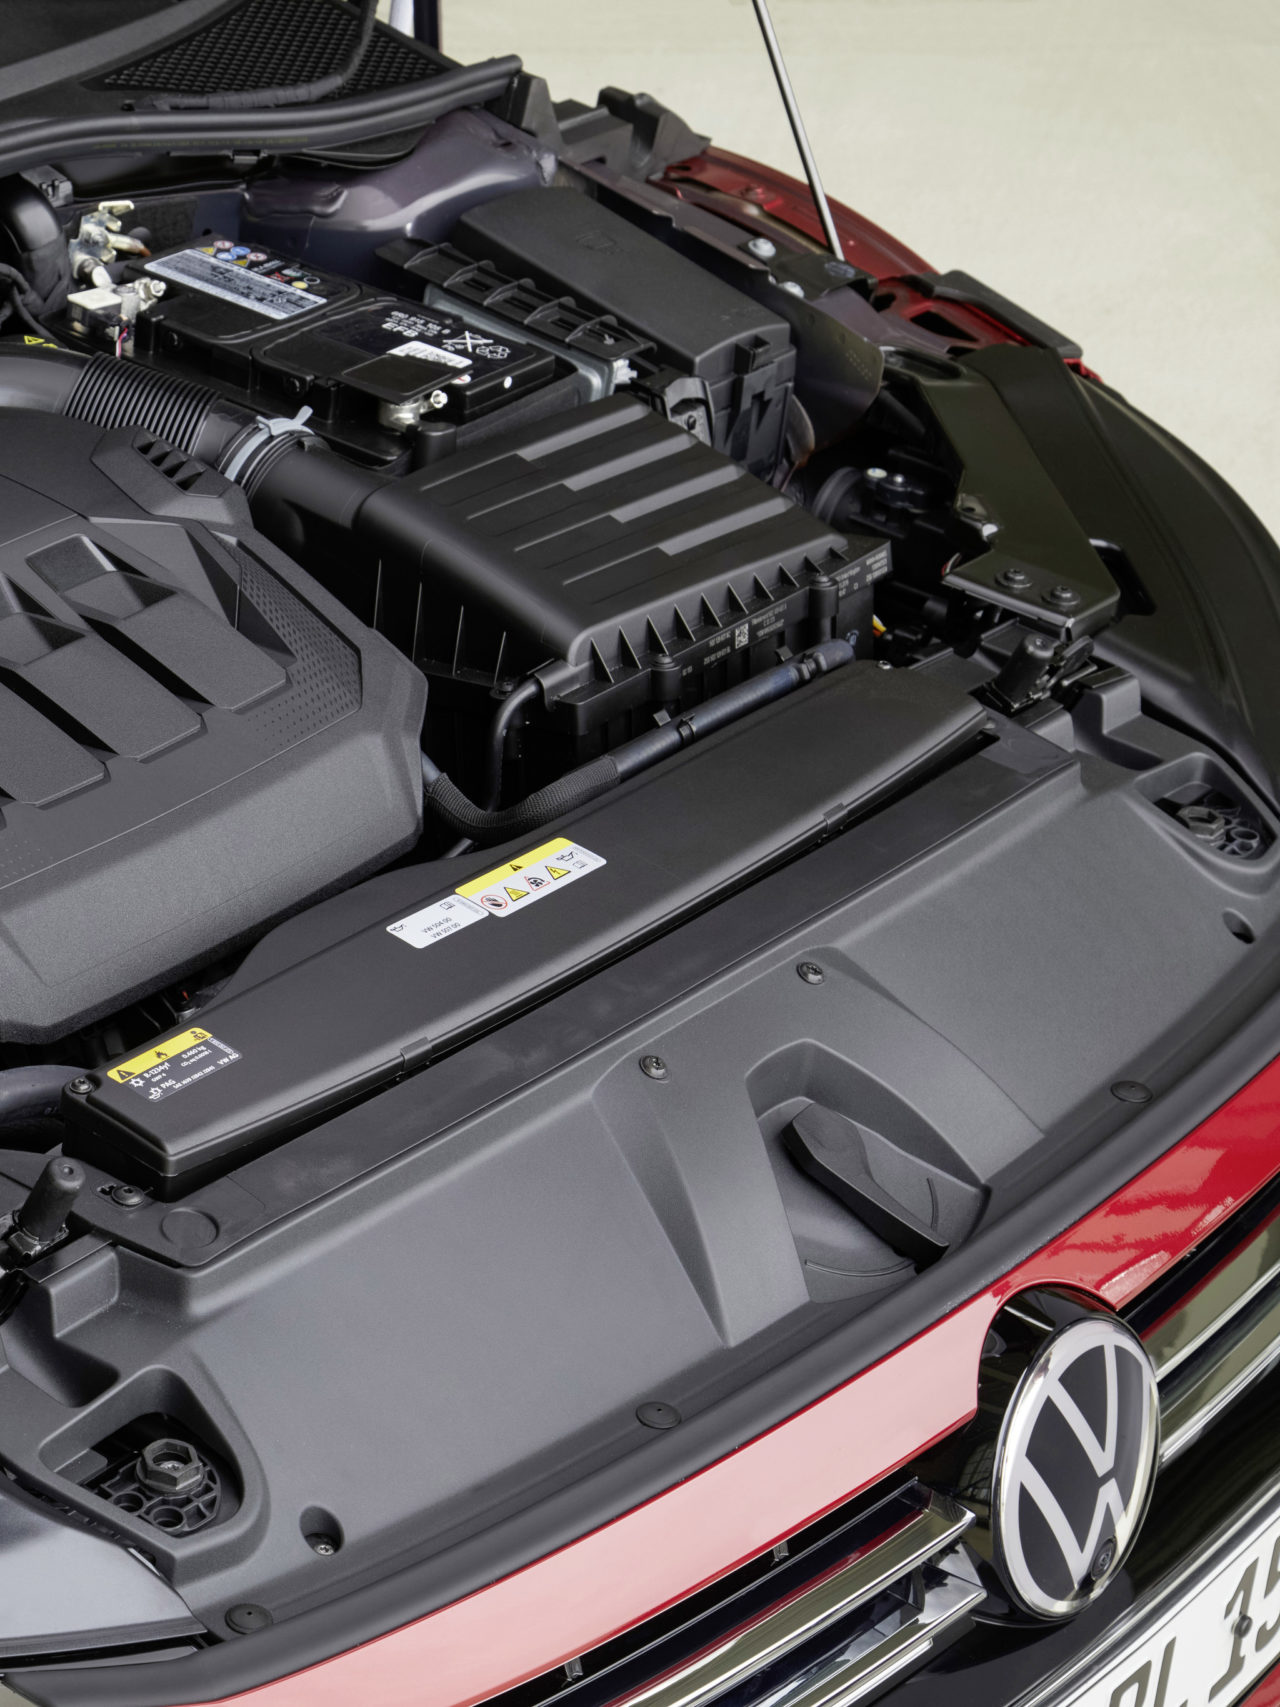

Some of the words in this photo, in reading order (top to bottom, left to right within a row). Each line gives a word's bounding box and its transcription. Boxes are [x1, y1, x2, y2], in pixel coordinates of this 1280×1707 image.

[381, 322, 419, 338] EFB
[143, 1062, 171, 1079] R-1234yf
[160, 1079, 176, 1089] PAG
